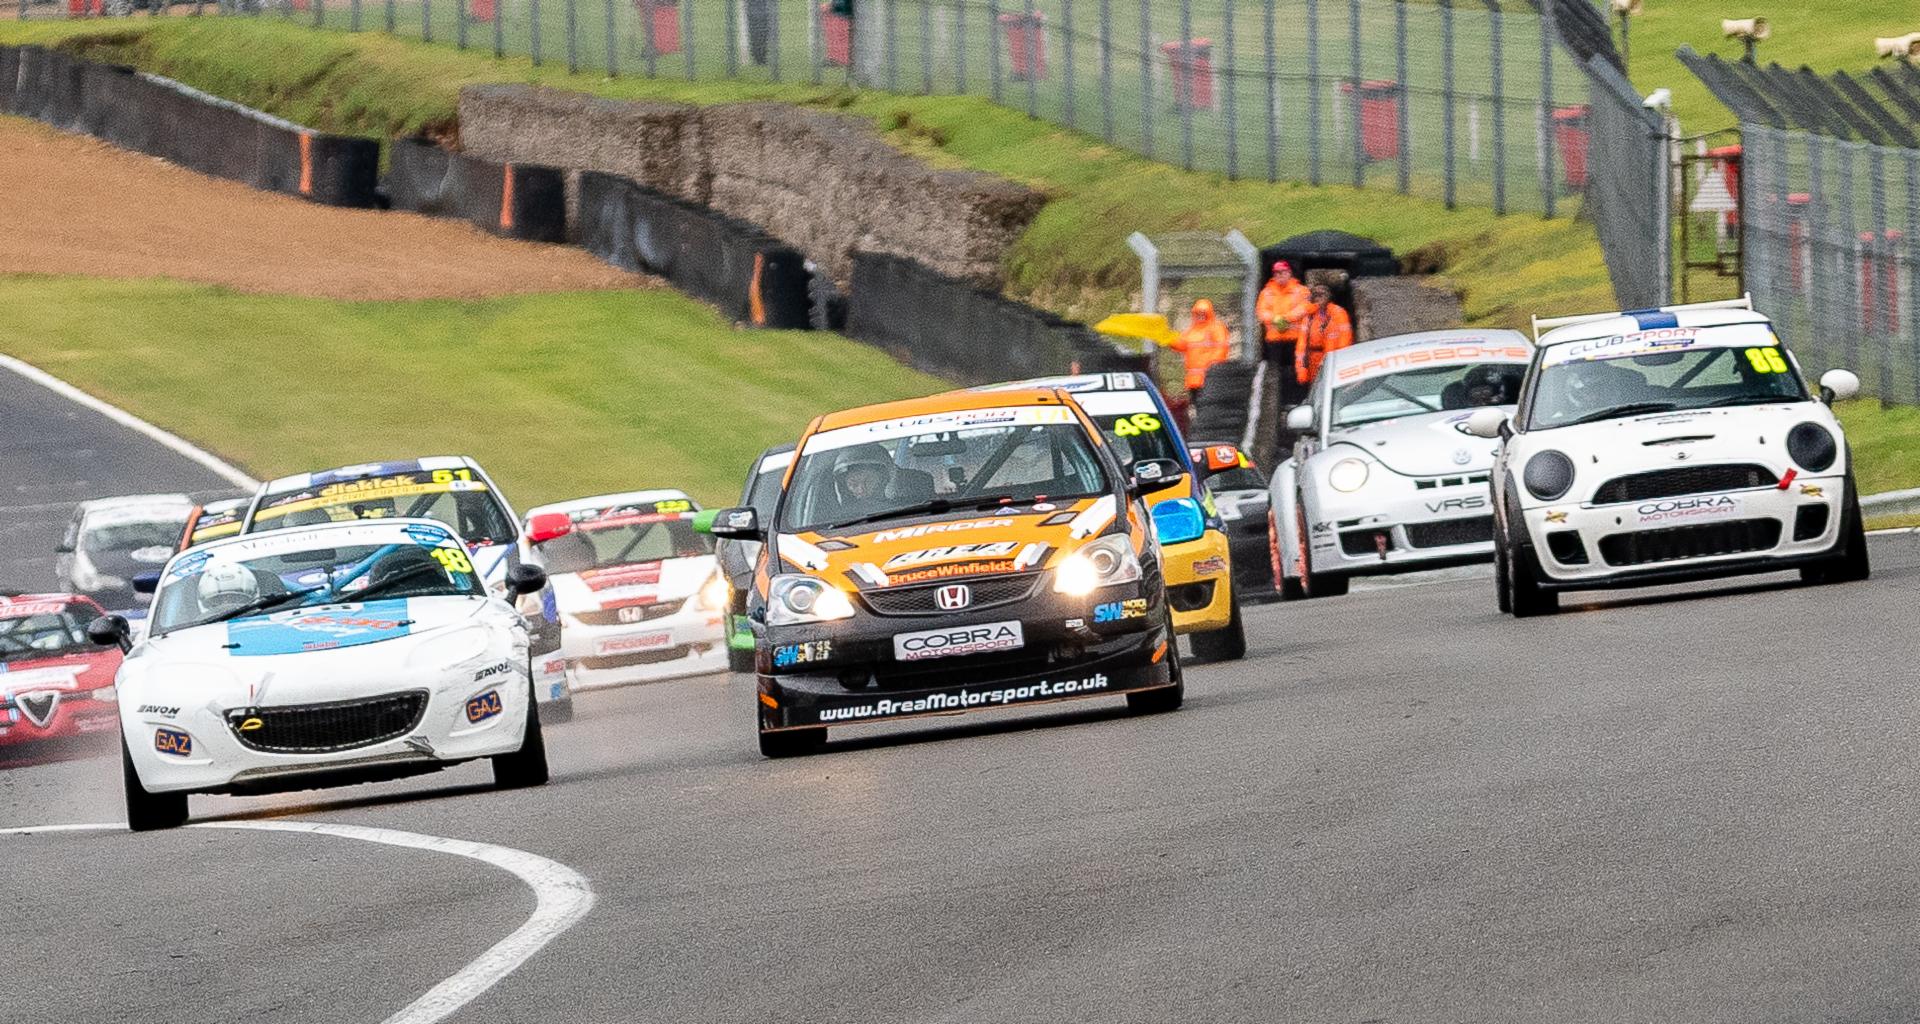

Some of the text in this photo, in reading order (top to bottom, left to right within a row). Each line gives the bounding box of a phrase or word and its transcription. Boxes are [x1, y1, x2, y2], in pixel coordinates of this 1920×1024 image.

[1744, 347, 1788, 373] 86
[1114, 413, 1161, 437] 46
[432, 469, 472, 484] 51
[1425, 496, 1486, 513] VRS
[1638, 496, 1735, 514] COBRA
[1640, 505, 1736, 523] MOTORSPORT
[430, 549, 473, 574] 18
[902, 625, 1016, 651] COBRA
[467, 692, 501, 721] GAZ
[819, 673, 1108, 721] www.AreaMotorsport.co.uk
[144, 704, 181, 715] AVON
[155, 731, 192, 753] GAZ
